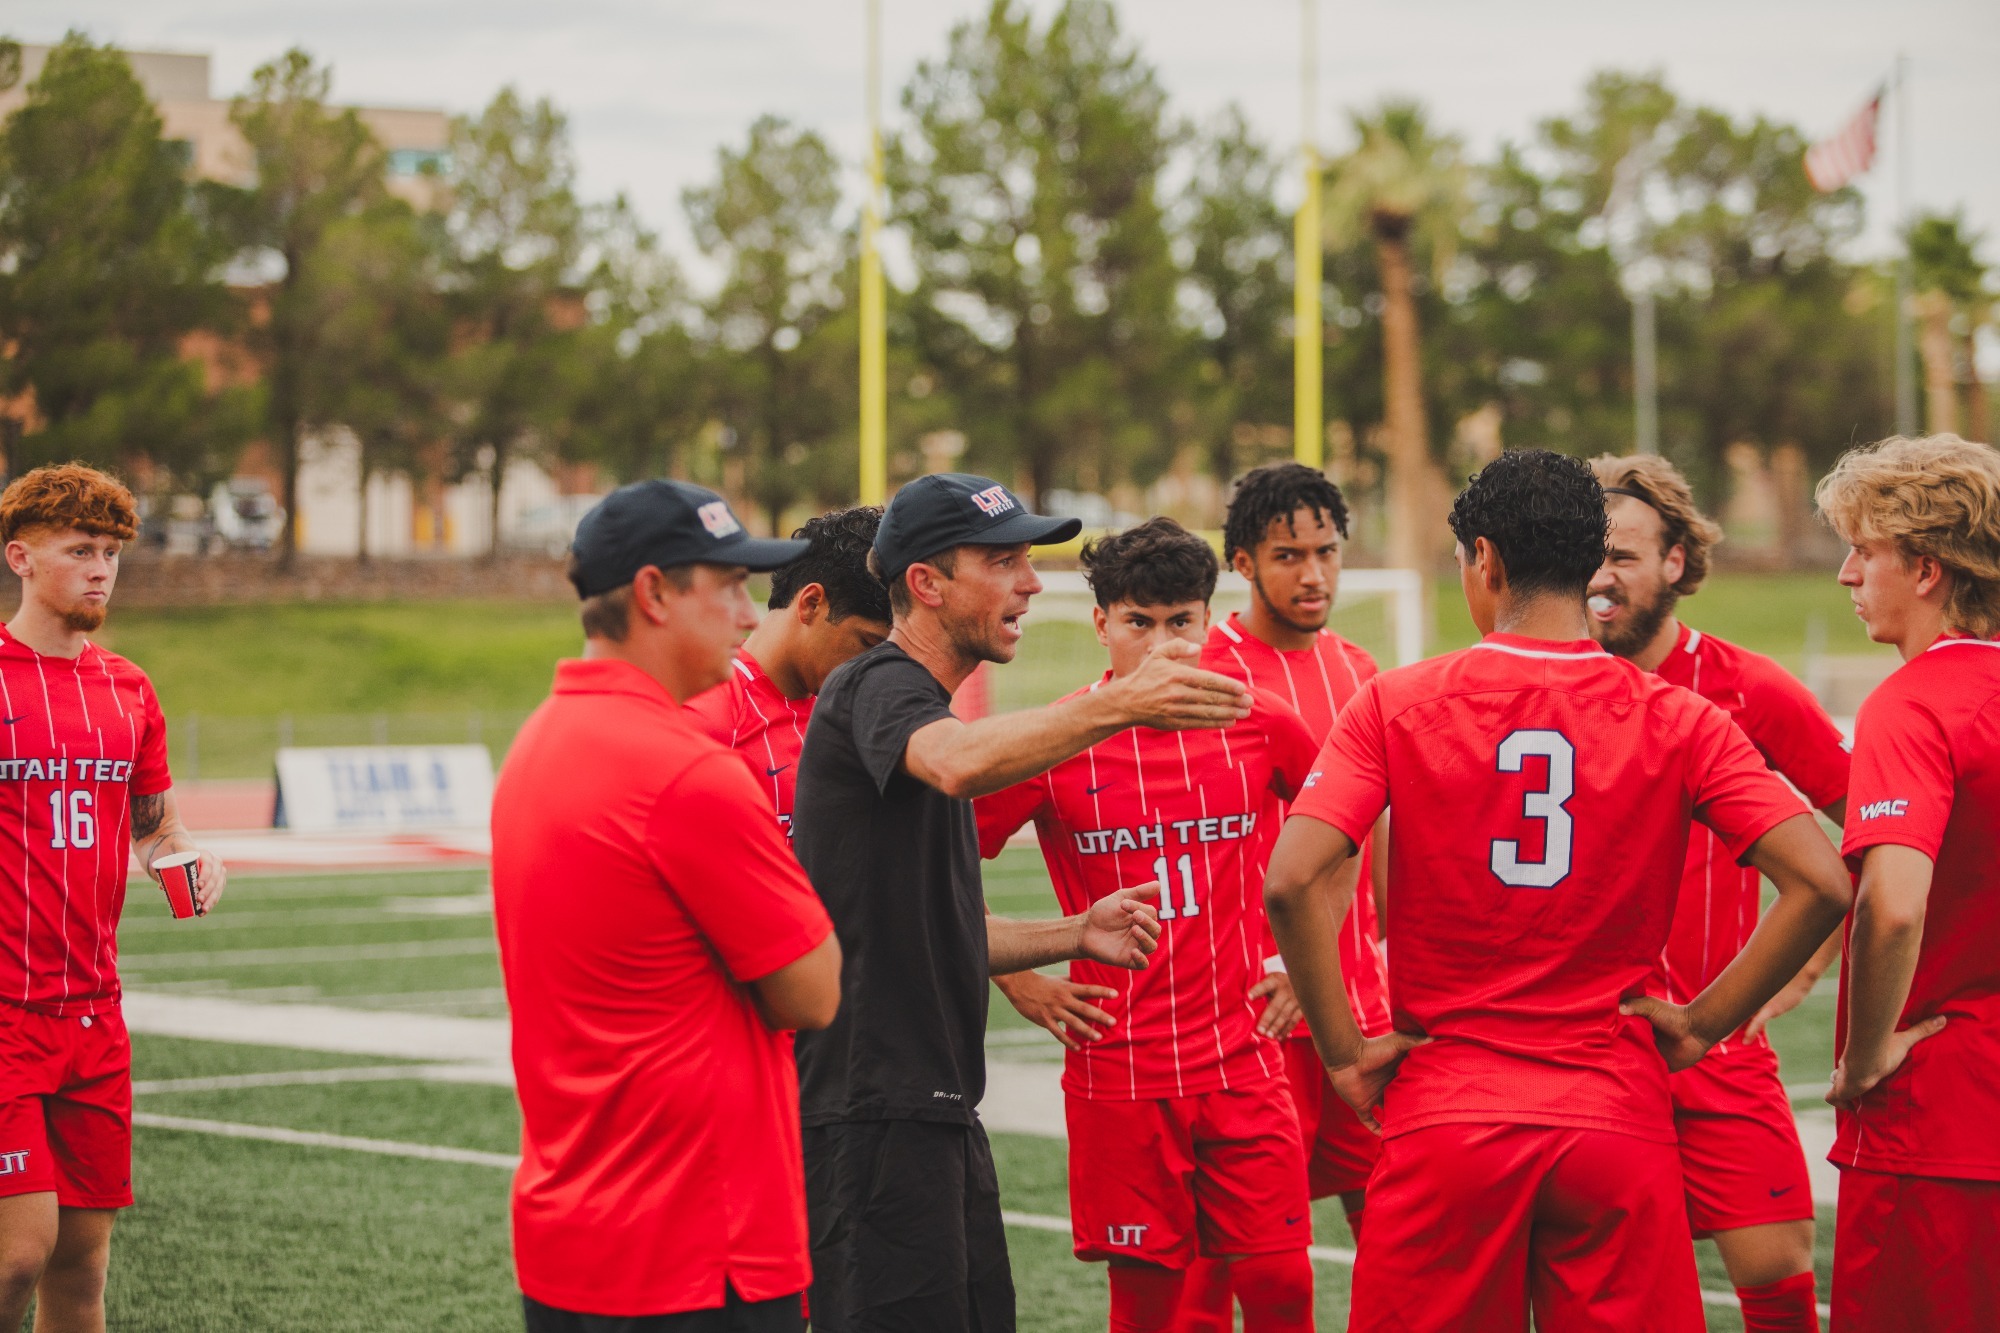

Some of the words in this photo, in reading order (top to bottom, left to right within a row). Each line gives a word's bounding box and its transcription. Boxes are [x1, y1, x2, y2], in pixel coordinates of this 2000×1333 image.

[970, 485, 1010, 512] UT
[48, 788, 96, 850] 16
[1489, 728, 1575, 889] 3
[1859, 799, 1909, 822] WAC
[1074, 823, 1165, 855] UTAH
[1171, 811, 1257, 845] TECH
[1152, 852, 1201, 921] 11
[933, 1090, 962, 1101] DRI-FIT
[1107, 1224, 1149, 1247] UT
